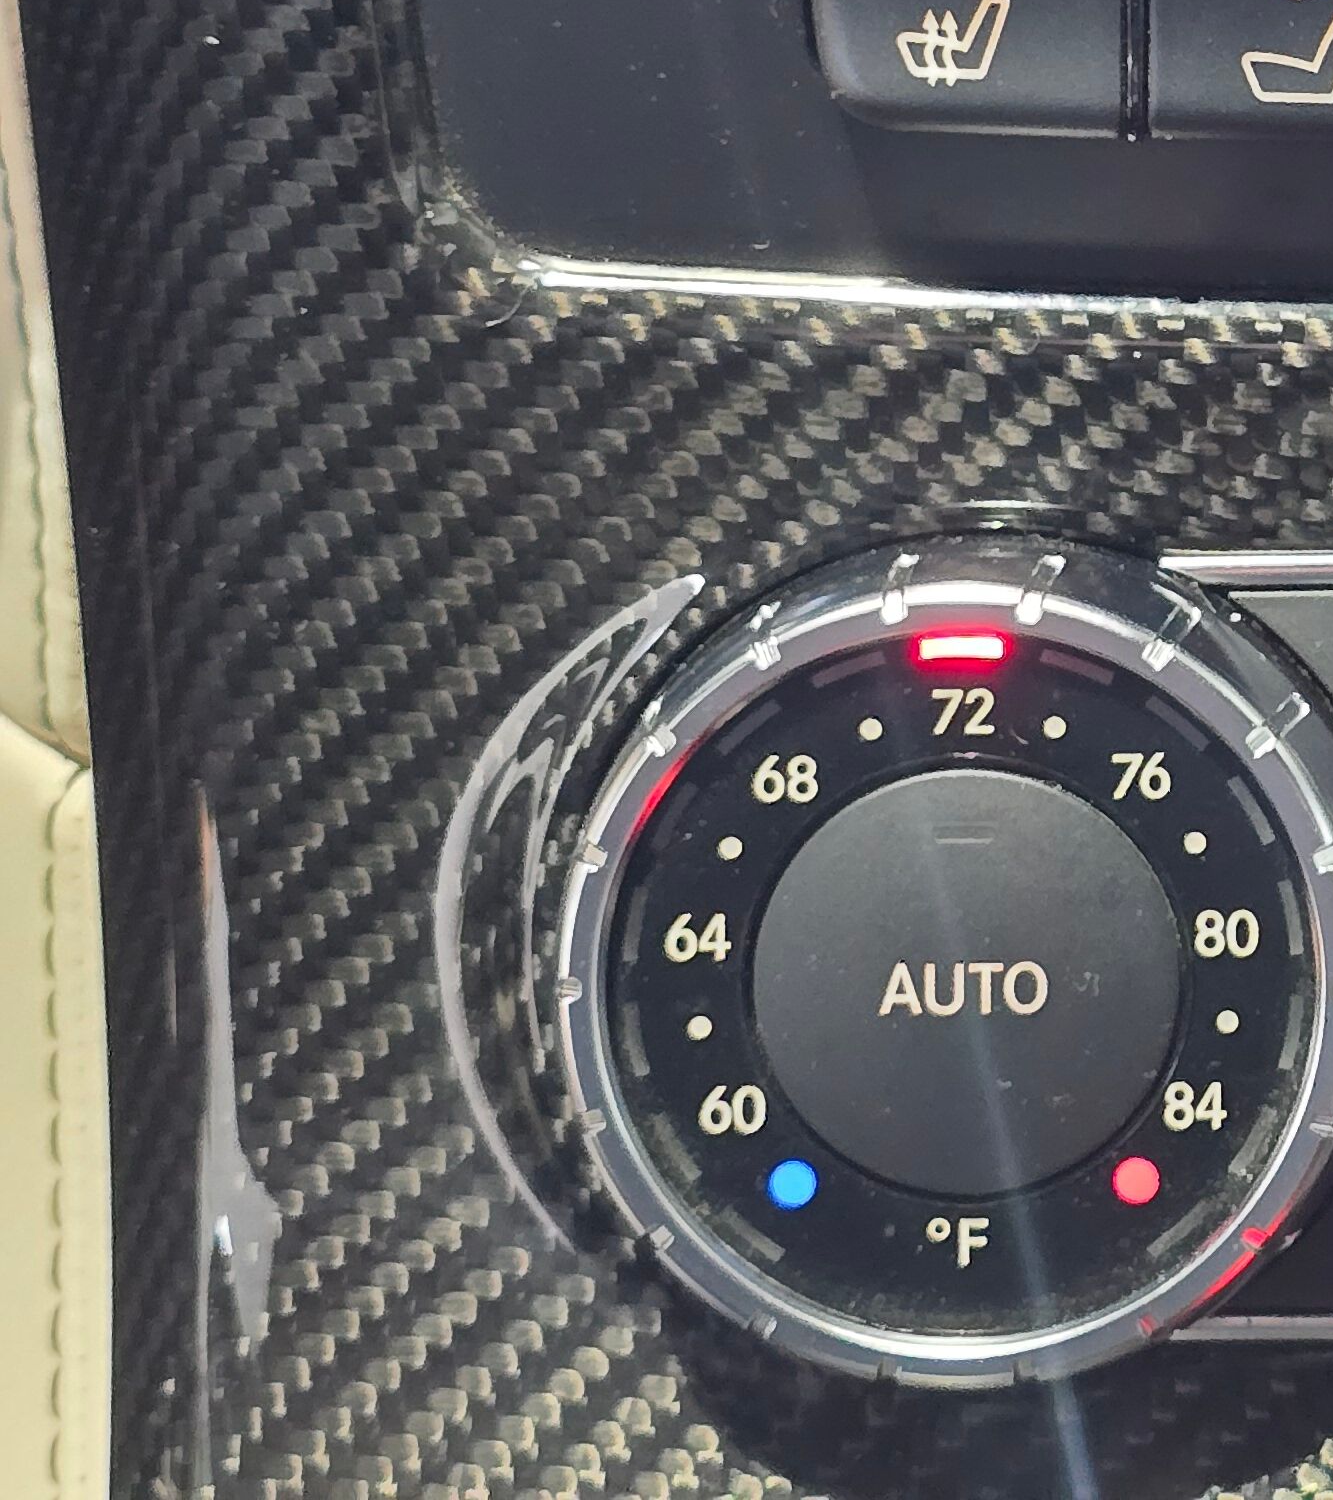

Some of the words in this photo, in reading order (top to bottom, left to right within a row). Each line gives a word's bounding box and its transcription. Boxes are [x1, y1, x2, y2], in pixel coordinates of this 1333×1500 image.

[931, 687, 995, 736] 72
[750, 754, 819, 804] 68
[1110, 751, 1172, 800] 76
[663, 912, 732, 963] 64
[1194, 908, 1260, 958] 80
[878, 960, 1049, 1017] AUTO
[698, 1084, 767, 1136] 60
[1163, 1080, 1228, 1132] 84
[925, 1217, 990, 1269] °F
